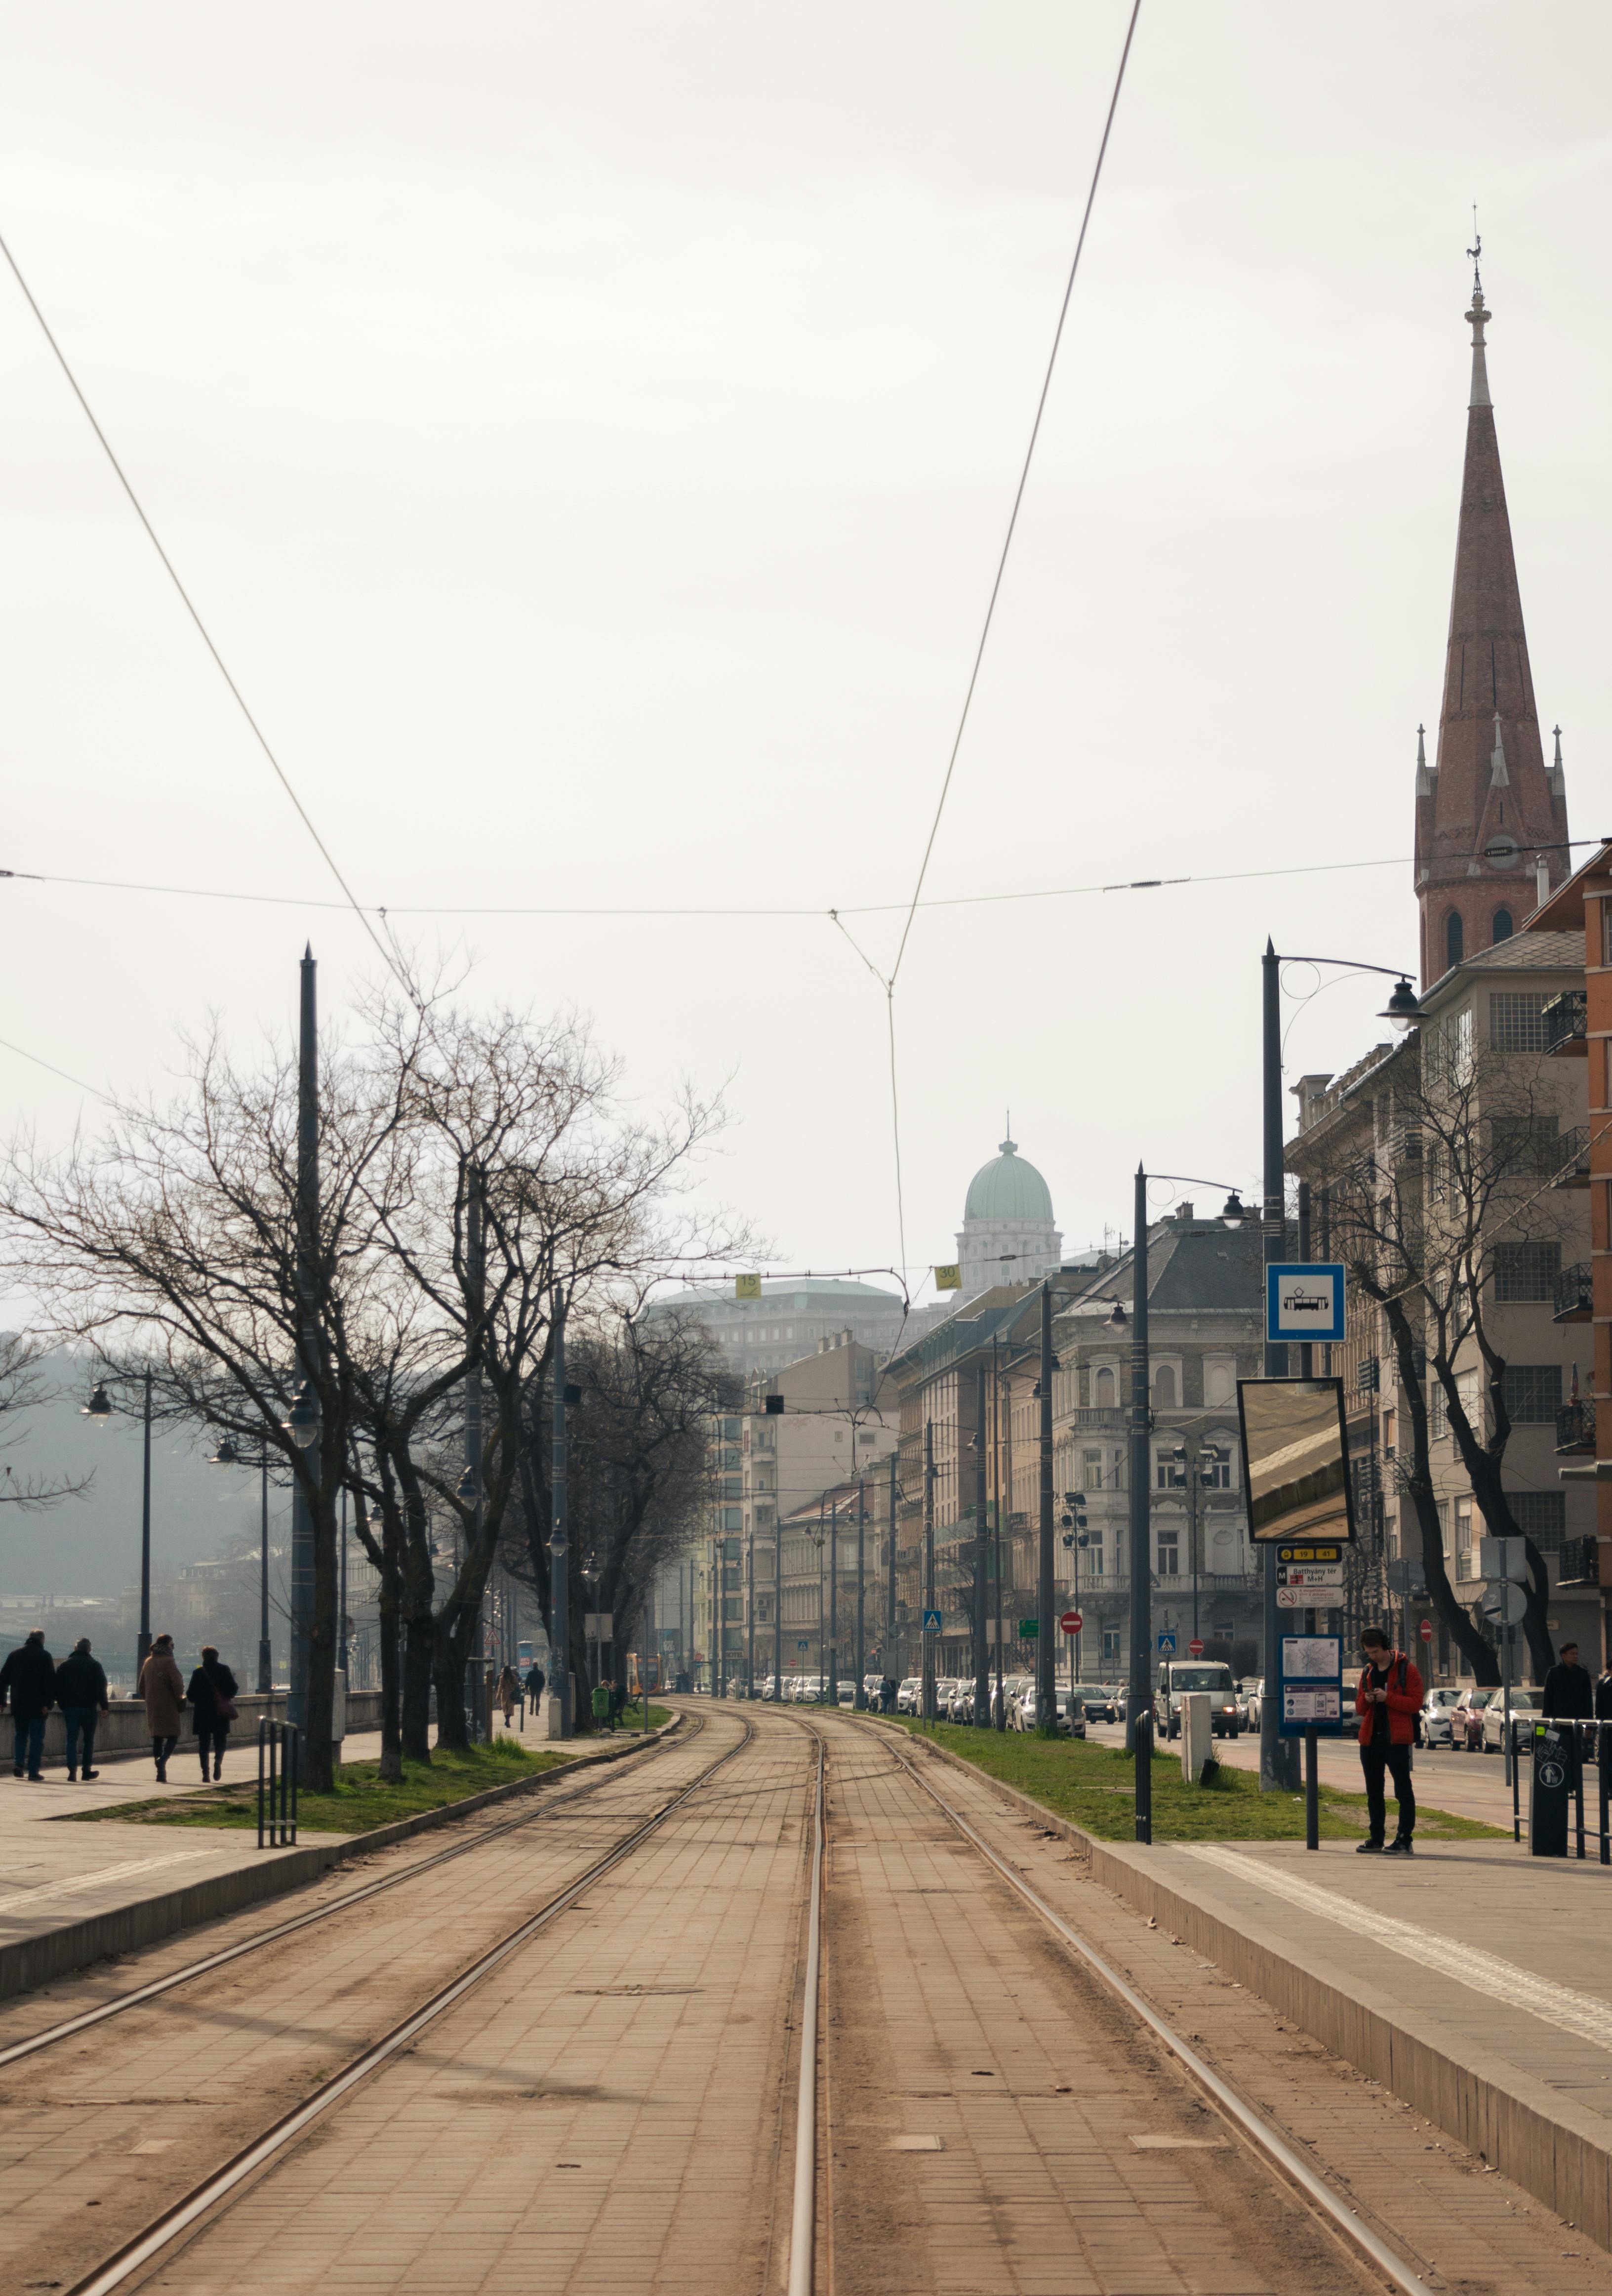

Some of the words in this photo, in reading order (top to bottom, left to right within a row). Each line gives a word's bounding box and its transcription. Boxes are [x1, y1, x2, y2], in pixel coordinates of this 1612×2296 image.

[940, 1267, 955, 1278] 30
[741, 1275, 756, 1286] 15
[1293, 1567, 1326, 1576] Batthyány
